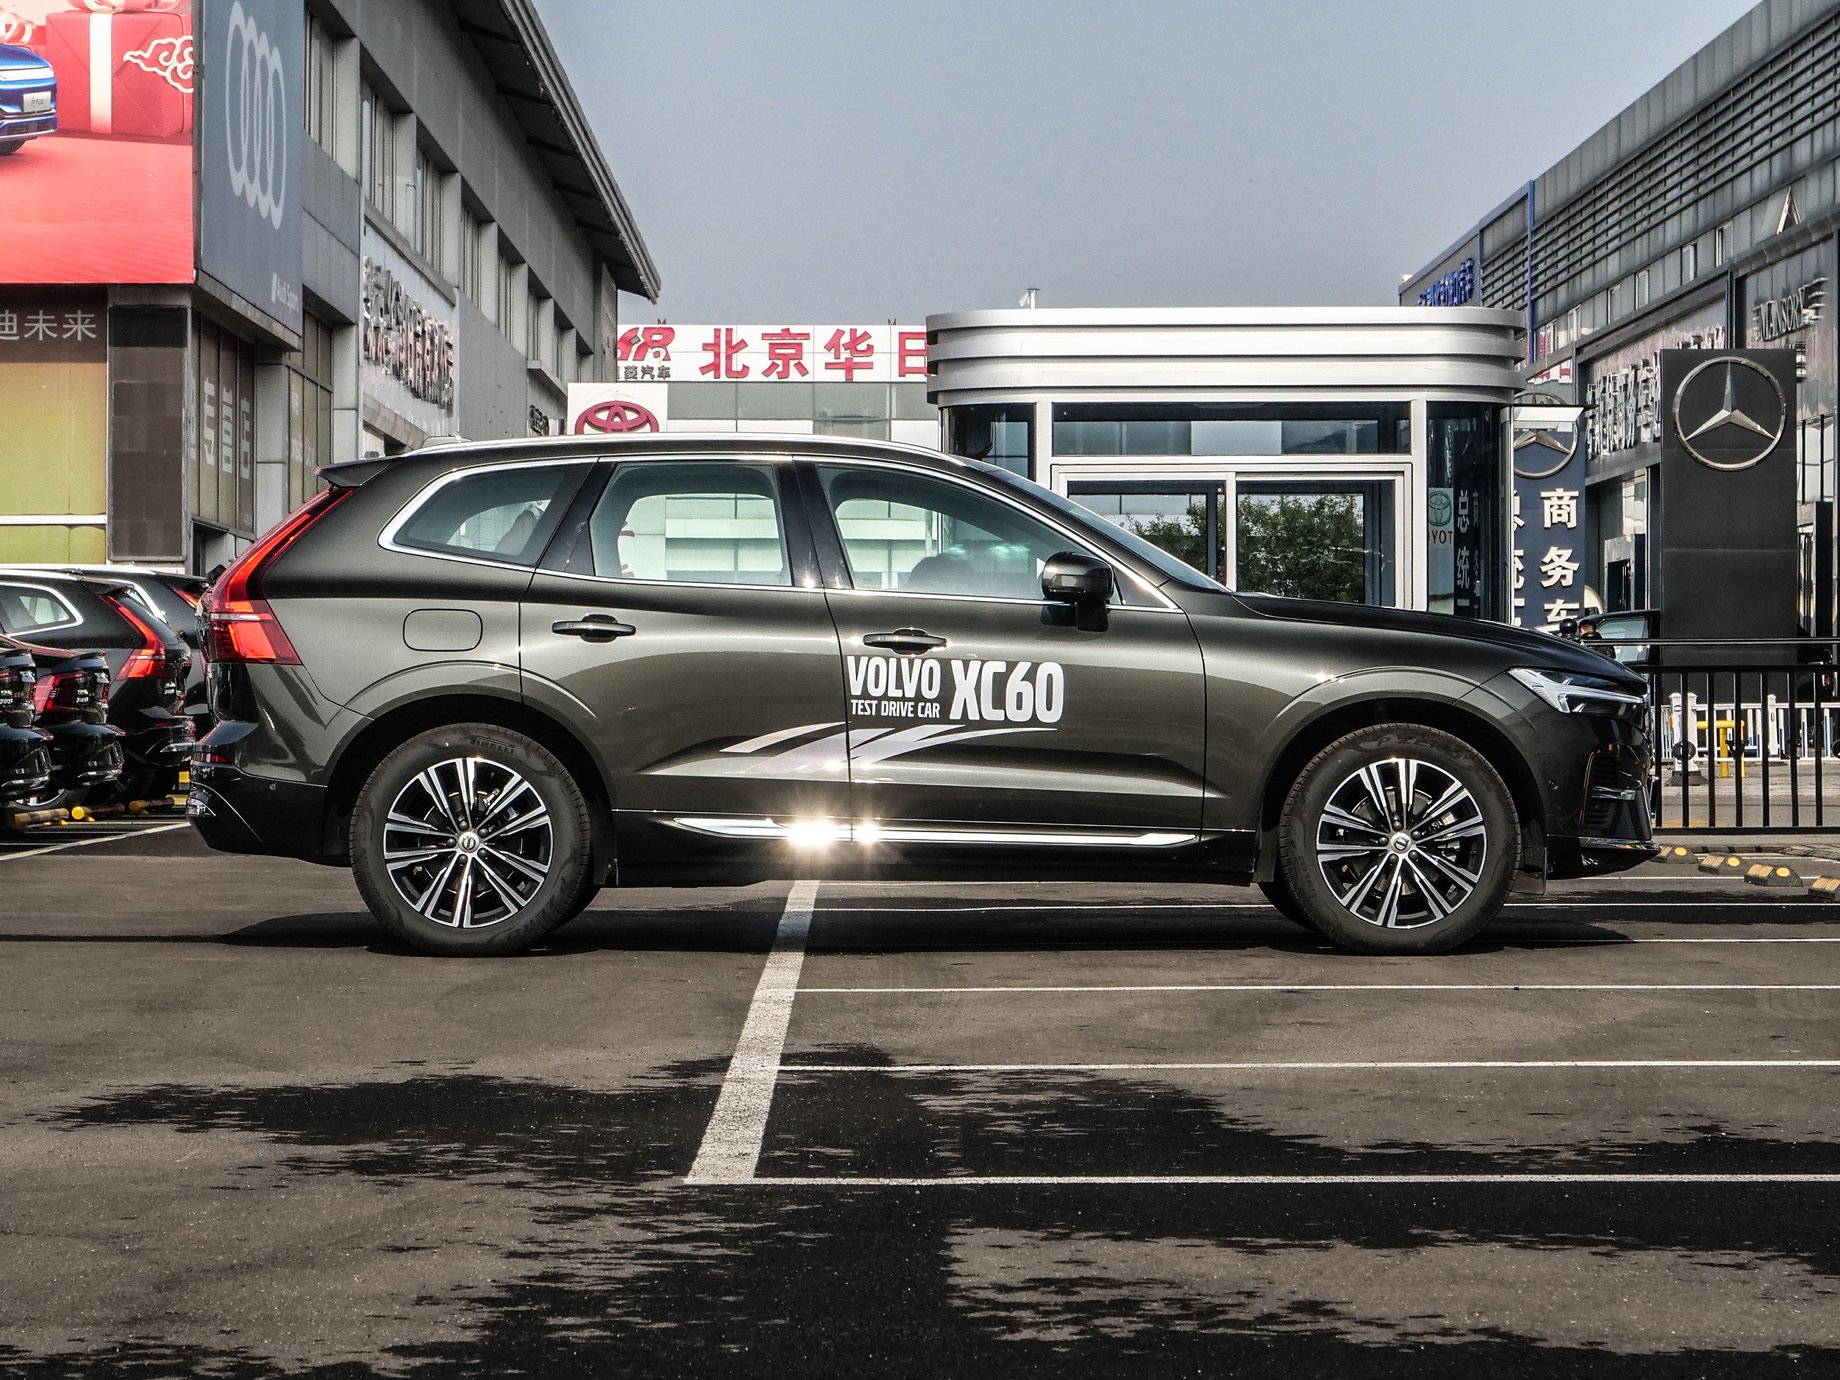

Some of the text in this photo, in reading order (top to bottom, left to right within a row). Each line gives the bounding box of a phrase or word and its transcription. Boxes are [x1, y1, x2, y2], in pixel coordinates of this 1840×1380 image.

[617, 364, 671, 380] 菱汽车
[699, 327, 928, 381] 北京华日
[847, 656, 1065, 723] VOLVO XC60
[851, 699, 941, 719] TEST DRIVE CAR
